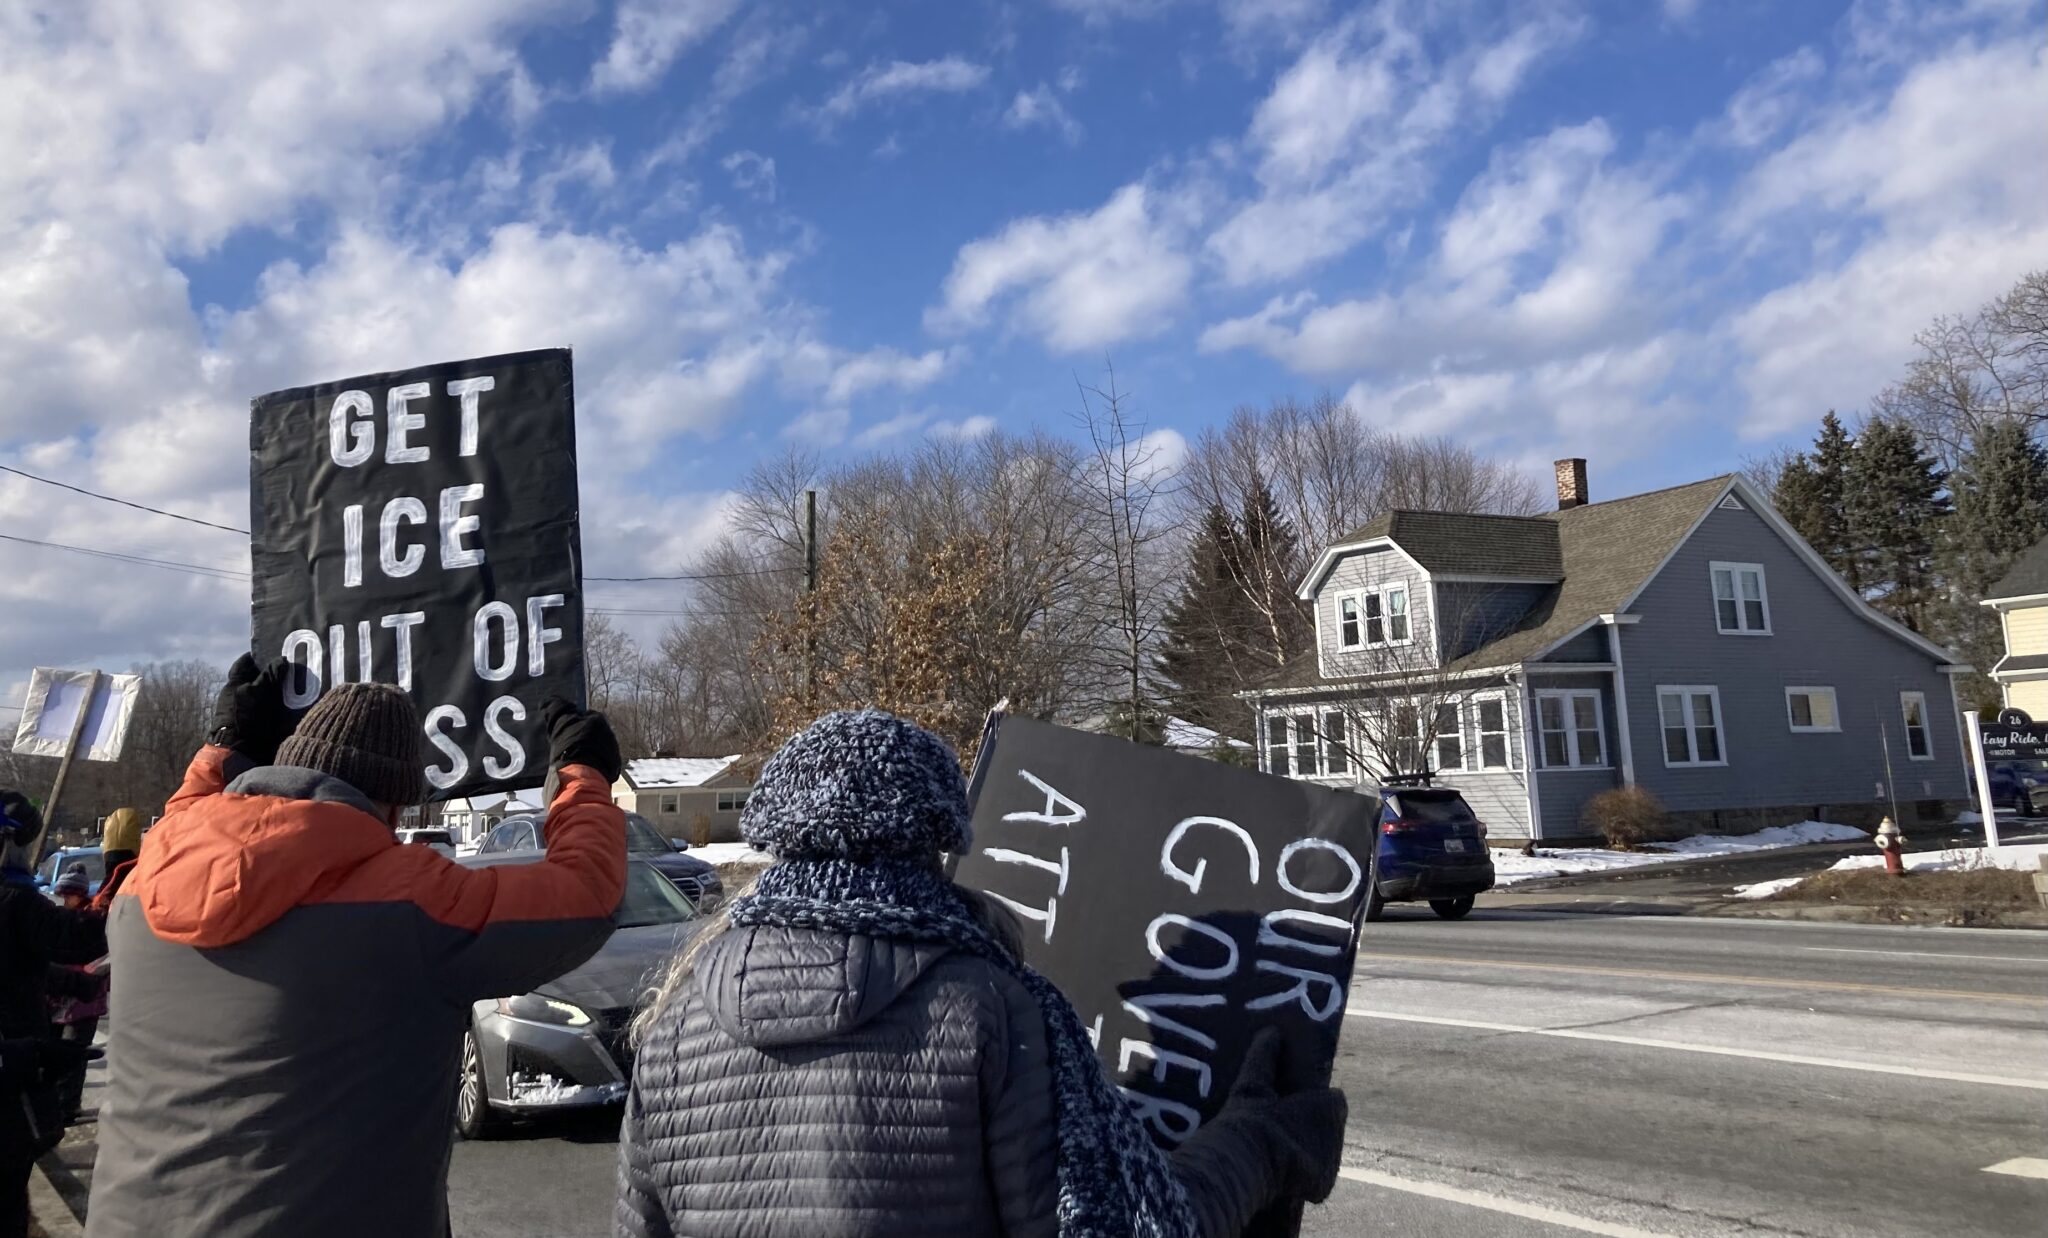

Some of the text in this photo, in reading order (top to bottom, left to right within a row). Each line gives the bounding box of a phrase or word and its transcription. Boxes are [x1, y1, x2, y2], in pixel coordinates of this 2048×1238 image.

[329, 375, 495, 467] GET
[343, 483, 485, 588] ICE
[281, 593, 565, 710] OUT OF
[423, 695, 526, 790] SS
[1983, 732, 2007, 748] Easy
[2009, 715, 2022, 725] 26
[1244, 837, 1362, 1021] OUR
